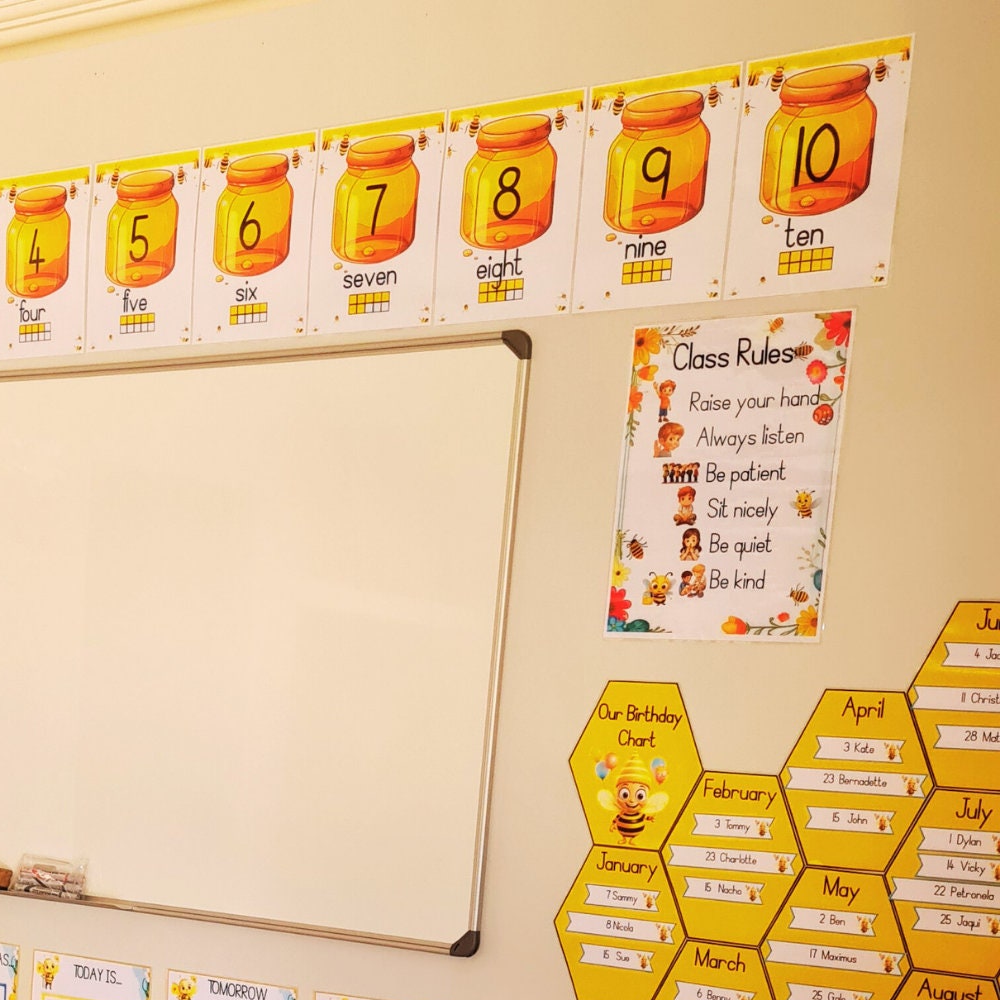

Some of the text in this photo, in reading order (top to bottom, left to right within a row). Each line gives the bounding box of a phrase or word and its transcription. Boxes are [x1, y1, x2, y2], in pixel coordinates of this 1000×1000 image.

[793, 123, 840, 188] 10
[642, 146, 672, 200] 9
[493, 167, 521, 220] 8
[366, 185, 387, 236] 7
[129, 215, 149, 262] 5
[239, 201, 261, 250] 6
[785, 221, 824, 247] ten
[29, 229, 45, 274] 4
[624, 233, 666, 260] nine
[343, 268, 397, 289] seven
[476, 250, 523, 289] eight
[123, 289, 147, 312] five
[235, 281, 258, 301] six
[19, 301, 45, 322] four
[673, 336, 794, 370] Class Rules
[689, 385, 821, 418] Raise your hand
[696, 424, 804, 453] Always listen
[706, 460, 786, 490] Be patient
[707, 498, 778, 525] Sit nicely
[709, 532, 772, 561] Be quiet
[710, 569, 765, 589] Be kind
[599, 703, 682, 730] Our Birthday
[842, 697, 885, 726] April
[618, 729, 656, 748] Chart
[704, 779, 777, 810] February
[823, 774, 887, 788] 23 Bernadette
[715, 819, 750, 834] 3 Tommy
[956, 798, 992, 829] July
[597, 852, 658, 883] January
[705, 852, 757, 865] 23 Charlotte
[607, 890, 638, 905] 7 Sammy
[823, 875, 860, 906] May
[934, 886, 946, 896] 22
[695, 947, 746, 972] March
[810, 949, 857, 964] 17 Maximus
[74, 964, 102, 980] TODAY
